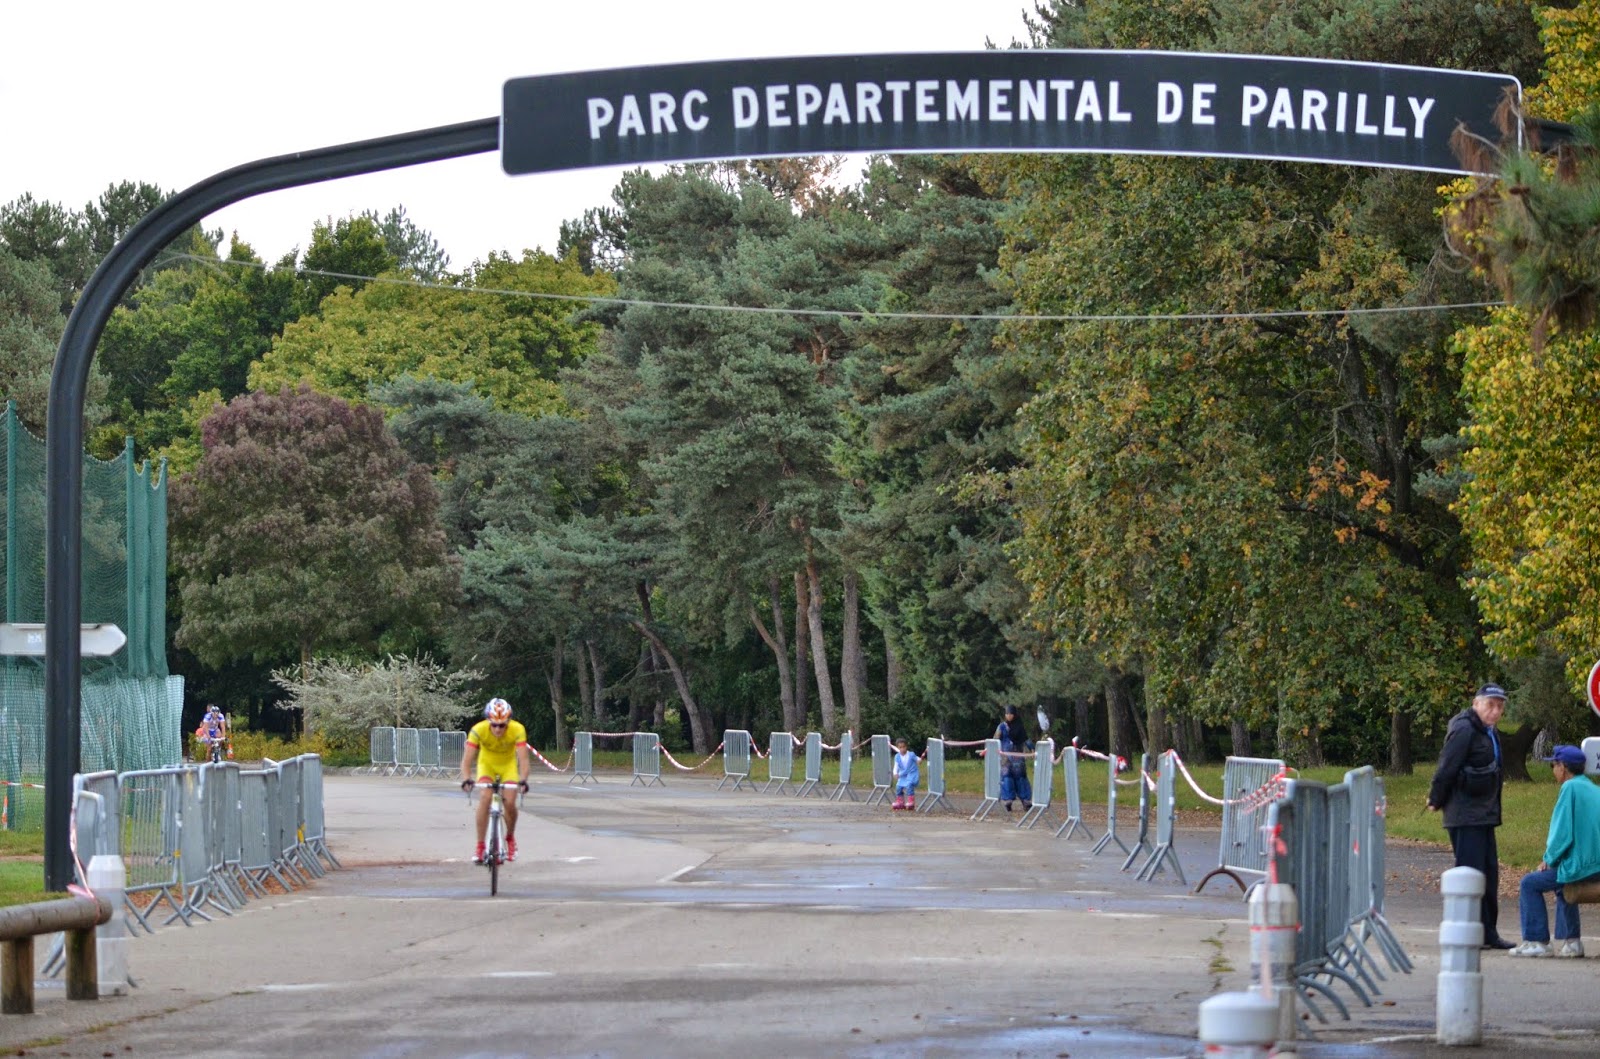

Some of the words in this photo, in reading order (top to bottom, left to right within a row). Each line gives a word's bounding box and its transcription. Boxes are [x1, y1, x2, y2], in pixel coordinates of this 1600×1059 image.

[587, 88, 710, 140] PARC
[732, 79, 1133, 129] DEPARTEMENTAL
[1156, 81, 1217, 125] DE
[1241, 85, 1435, 139] PARILLY
